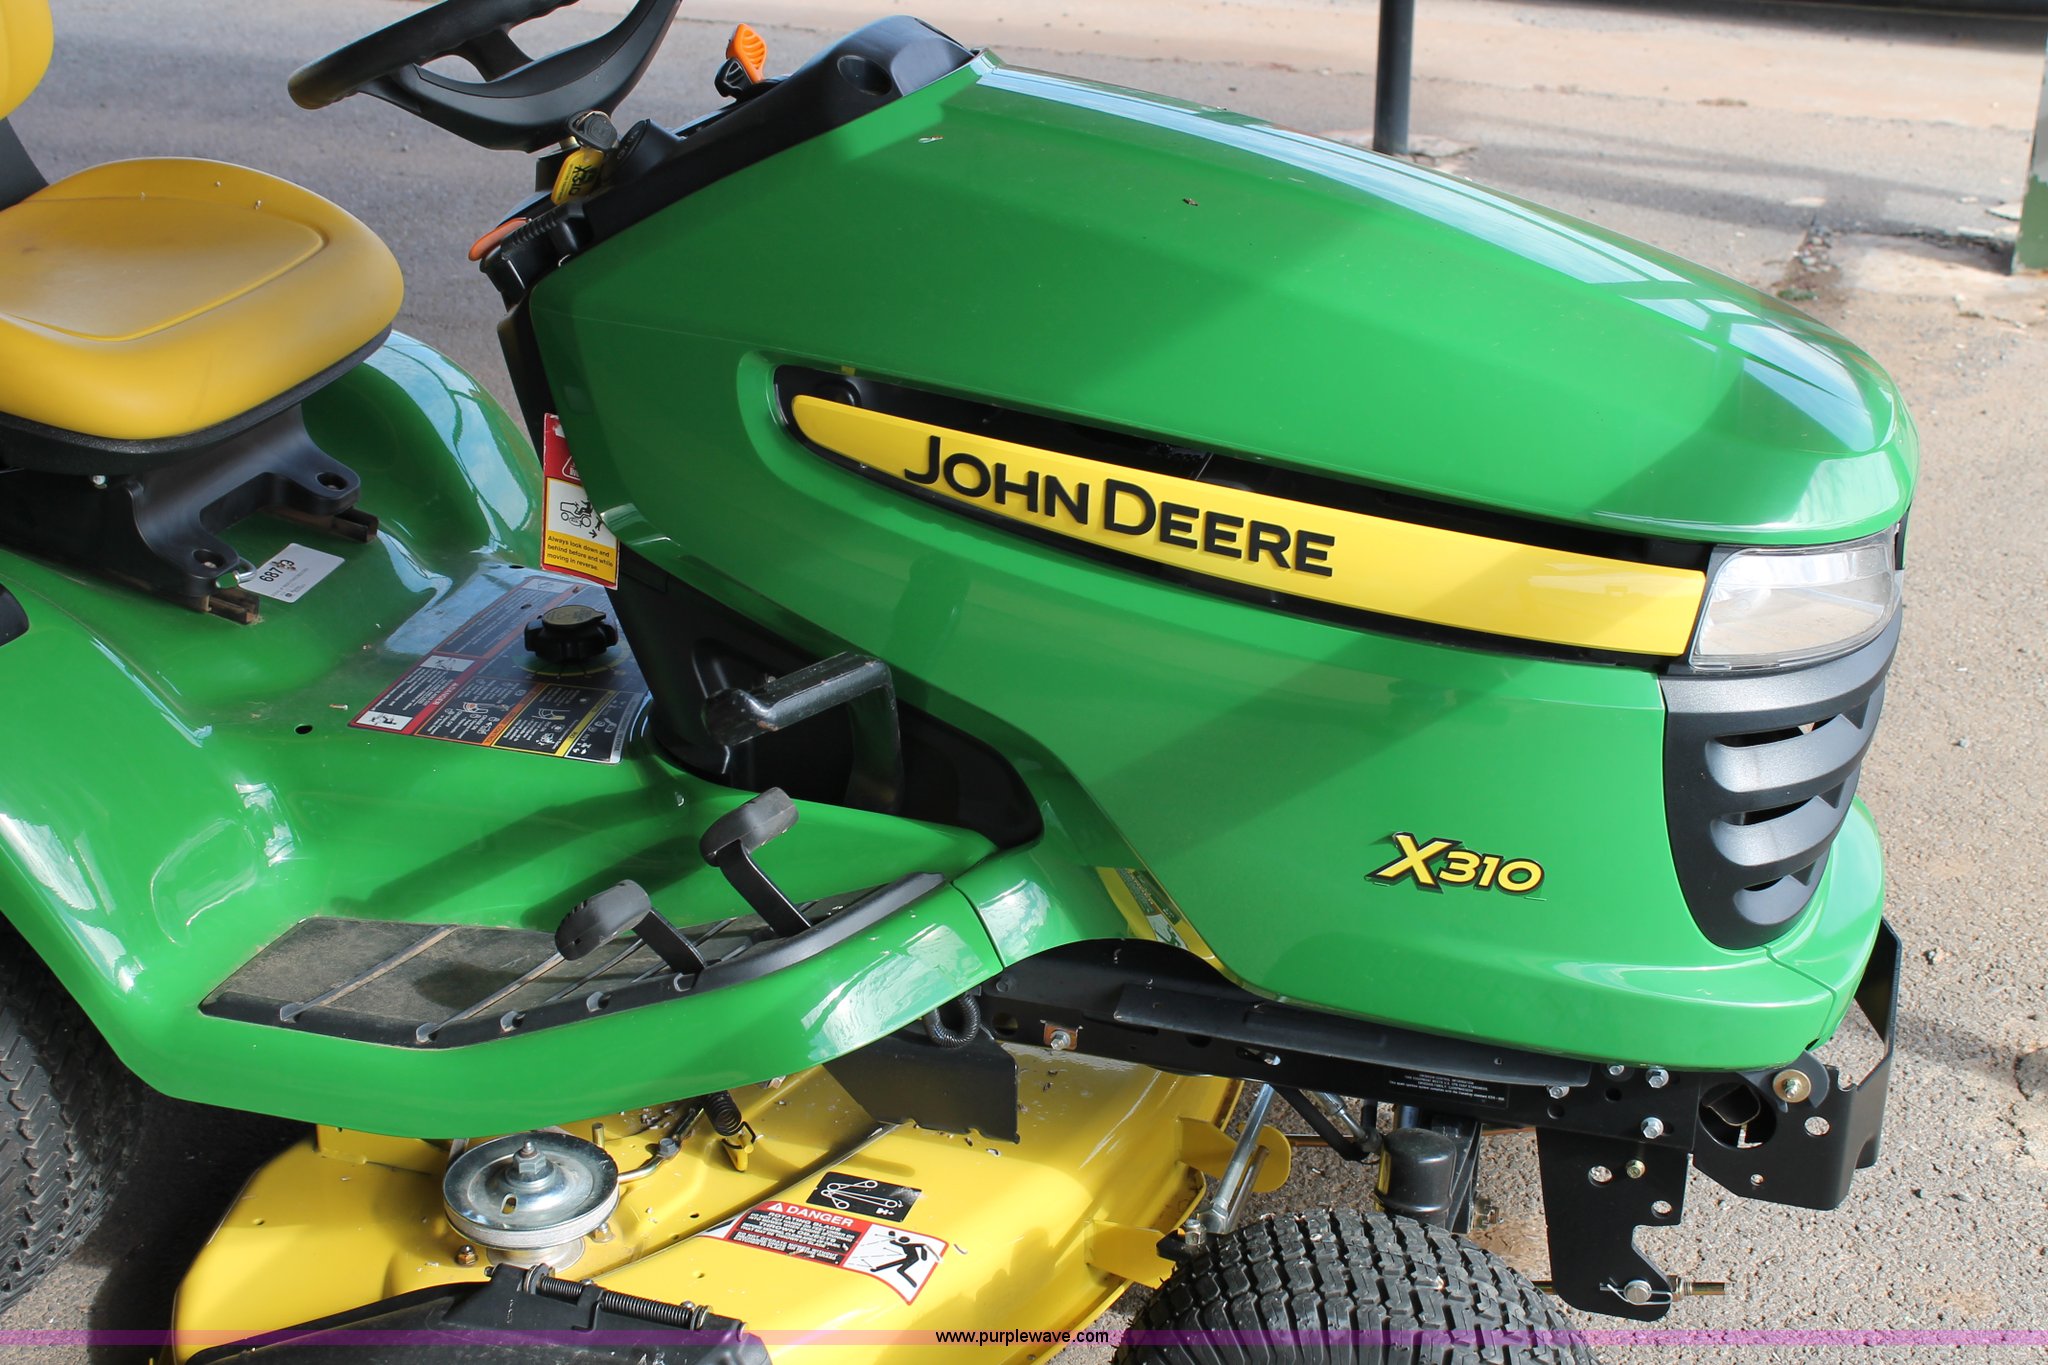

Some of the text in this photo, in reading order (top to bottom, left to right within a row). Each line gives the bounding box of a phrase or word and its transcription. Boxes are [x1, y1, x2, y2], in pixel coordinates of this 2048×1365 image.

[904, 435, 1335, 577] JOHN DEERE
[548, 536, 569, 546] Always
[570, 541, 582, 549] look
[583, 545, 598, 554] down
[548, 544, 568, 553] behind
[569, 549, 587, 559] before
[599, 558, 614, 567] while
[547, 553, 569, 563] moving
[576, 560, 599, 570] reverse.
[1365, 832, 1545, 894] X310
[768, 1212, 842, 1232] ROTATING BLADE
[786, 1205, 854, 1227] DANGER
[759, 1221, 797, 1234] THROWN
